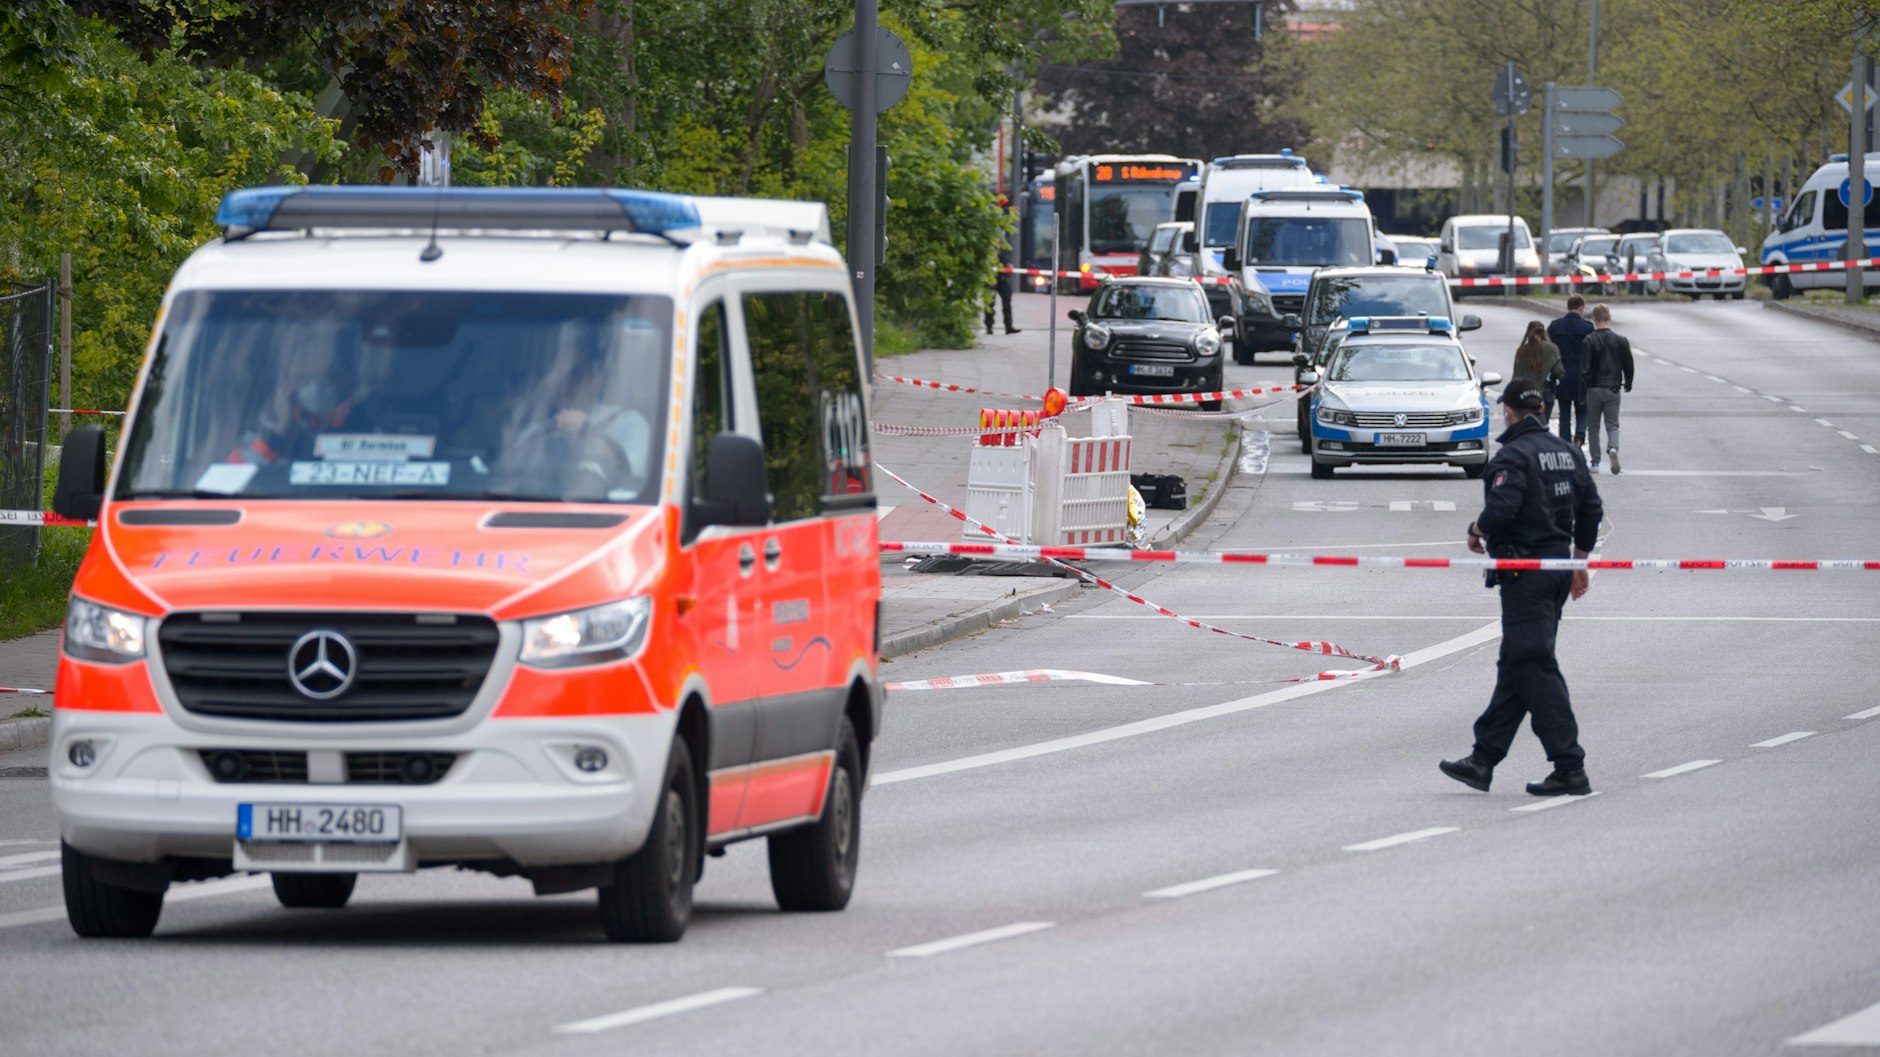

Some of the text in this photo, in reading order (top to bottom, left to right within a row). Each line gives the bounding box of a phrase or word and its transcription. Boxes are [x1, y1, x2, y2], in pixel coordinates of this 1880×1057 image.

[1383, 434, 1421, 443] HH 7222
[1538, 452, 1576, 471] POLIZEI
[309, 463, 436, 483] 23-NEF-A
[1554, 481, 1570, 496] HH
[152, 545, 529, 572] FEUERWEHR
[267, 809, 384, 834] HH 2480
